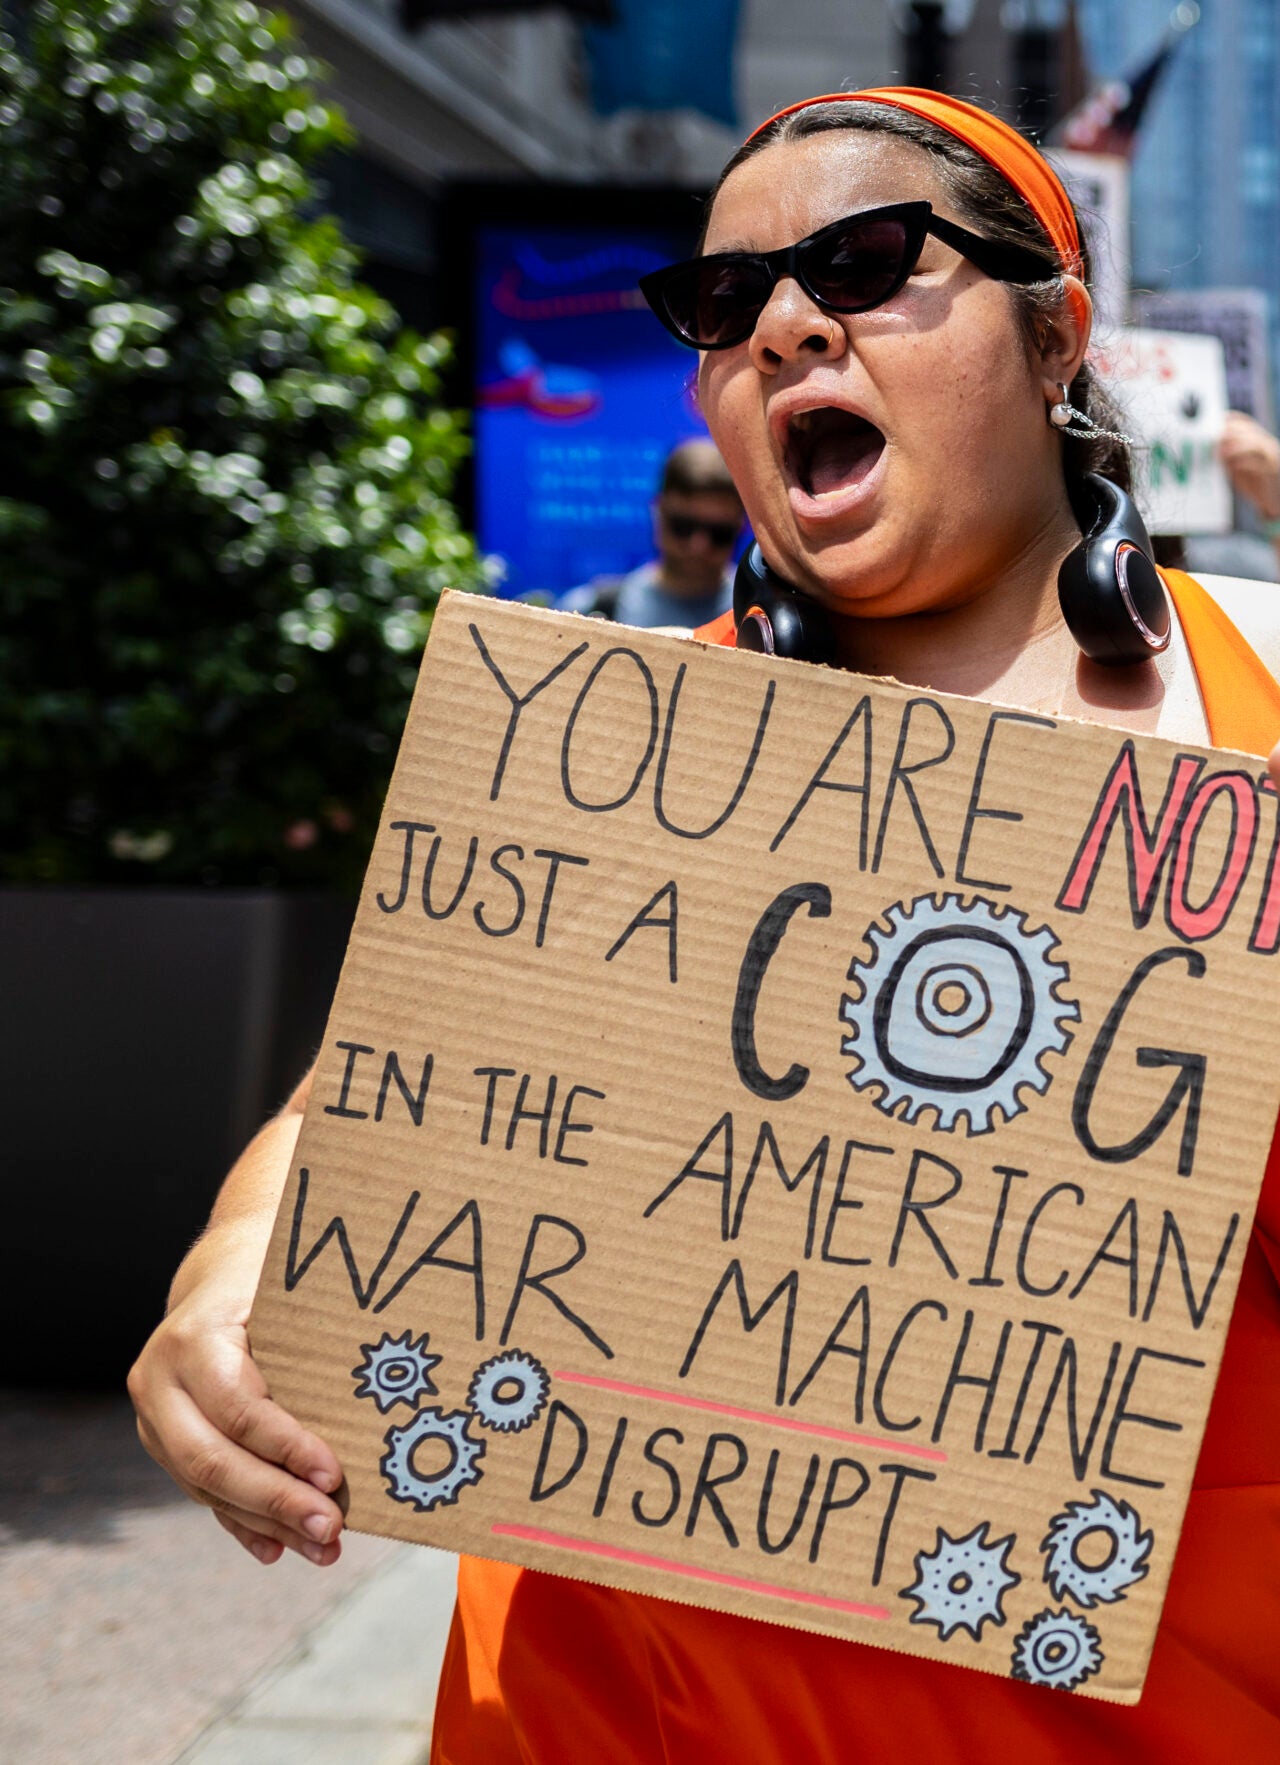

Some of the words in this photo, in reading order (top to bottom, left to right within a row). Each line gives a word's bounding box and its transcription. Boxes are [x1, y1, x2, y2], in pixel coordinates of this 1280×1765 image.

[468, 623, 777, 840] YOU
[769, 695, 1058, 892] ARE
[376, 820, 590, 948] JUST
[606, 880, 679, 984] A
[731, 882, 1210, 1177] COG
[284, 1168, 615, 1360] WAR
[679, 1259, 1206, 1489] MACHINE
[323, 1040, 434, 1127] IN
[473, 1067, 606, 1167] THE
[643, 1112, 1240, 1329] AMERICAN
[529, 1400, 938, 1586] DISRUPT
